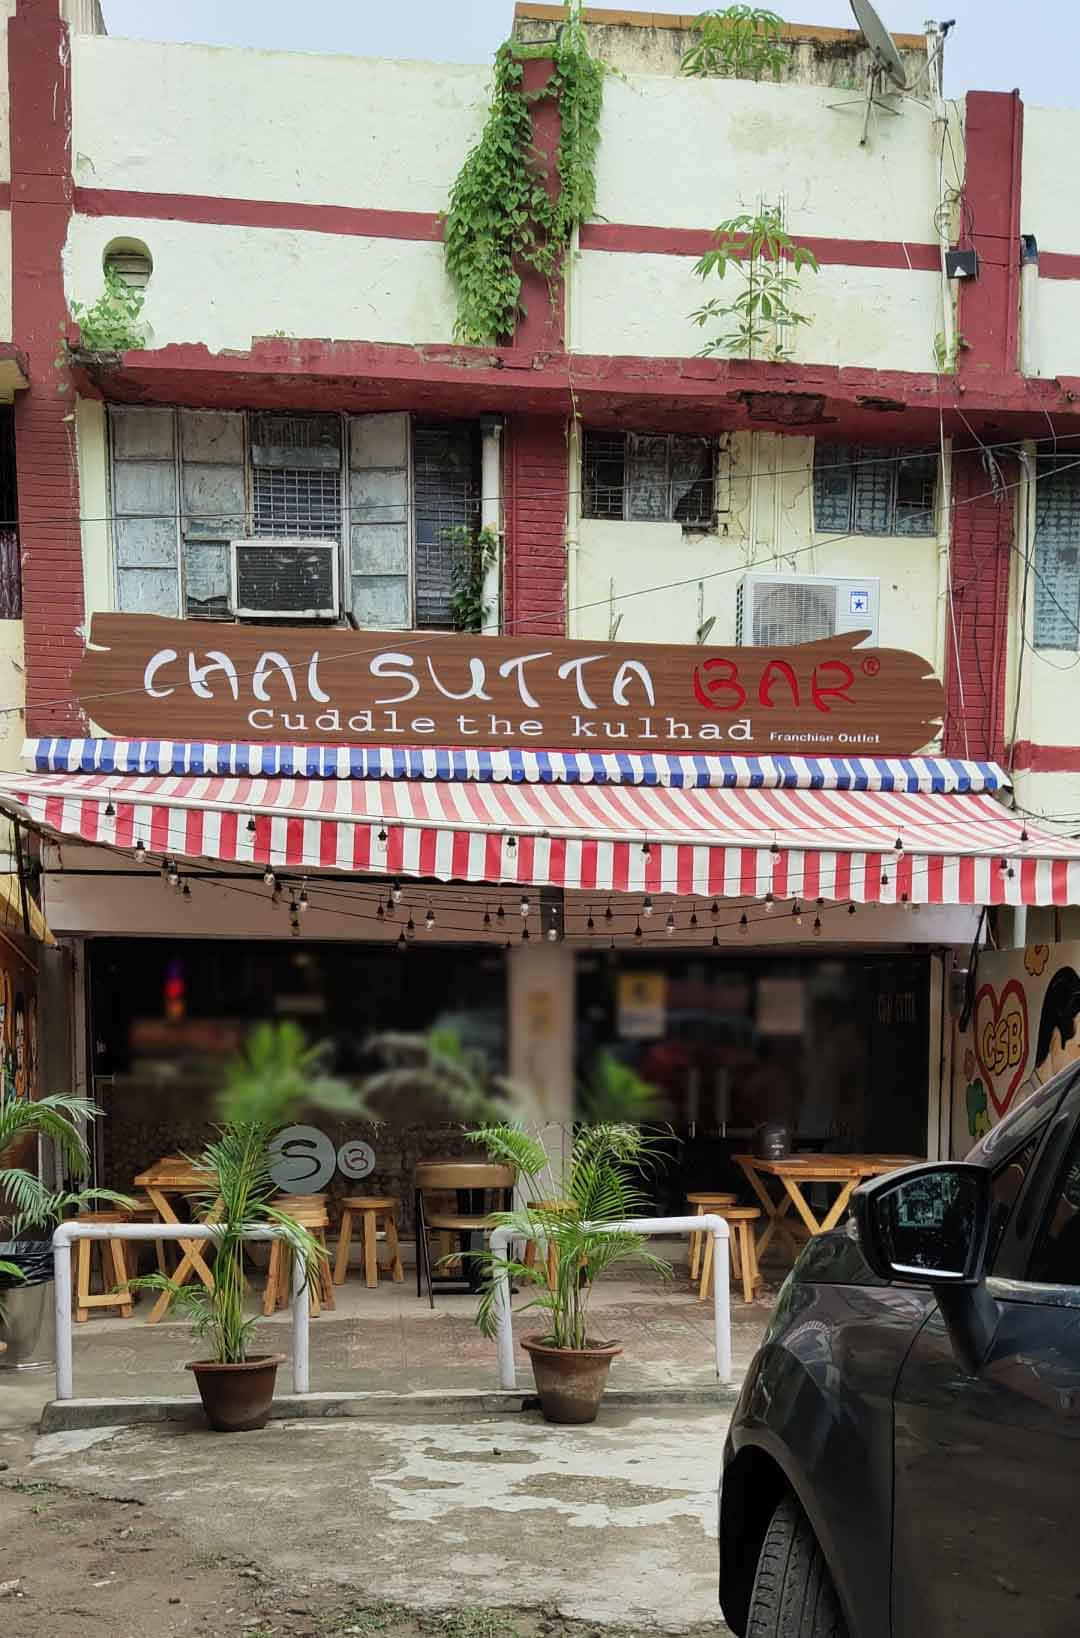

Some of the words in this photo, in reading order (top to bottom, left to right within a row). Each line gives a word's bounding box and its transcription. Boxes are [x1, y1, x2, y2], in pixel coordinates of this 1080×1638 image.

[144, 649, 331, 703] CHAI
[370, 651, 656, 710] SUTTA
[247, 708, 436, 734] Cuddle
[456, 713, 545, 736] the
[571, 715, 755, 741] kulhad
[769, 731, 834, 742] Franchise
[838, 733, 881, 743] Outlet
[983, 1010, 1023, 1076] CSB
